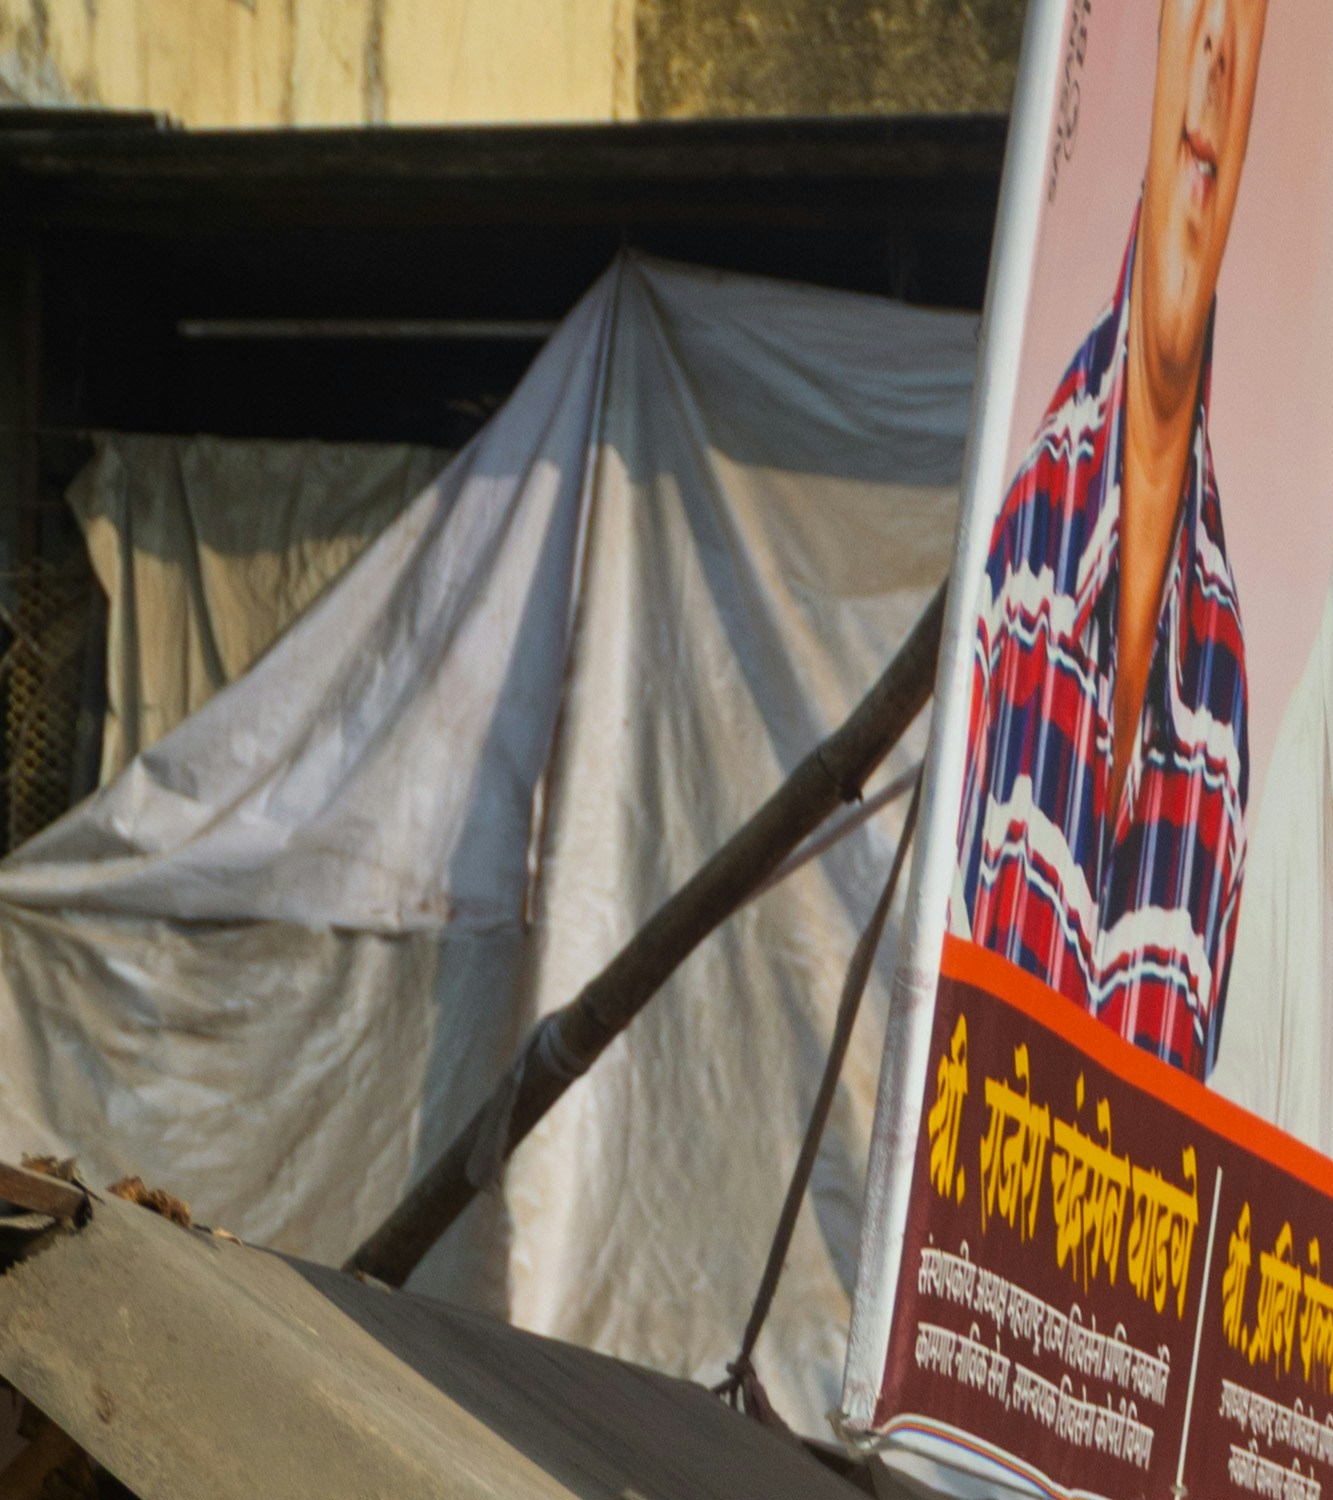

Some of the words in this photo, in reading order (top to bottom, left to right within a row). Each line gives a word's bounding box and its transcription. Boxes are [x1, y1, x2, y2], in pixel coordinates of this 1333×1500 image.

[928, 1013, 968, 1206] श्री.
[980, 1043, 1050, 1243] राजेश
[1051, 1071, 1131, 1296] चंद्रसेन
[1007, 1283, 1046, 1356] महाराष्ट्र
[1065, 1303, 1107, 1378] शिवसेना
